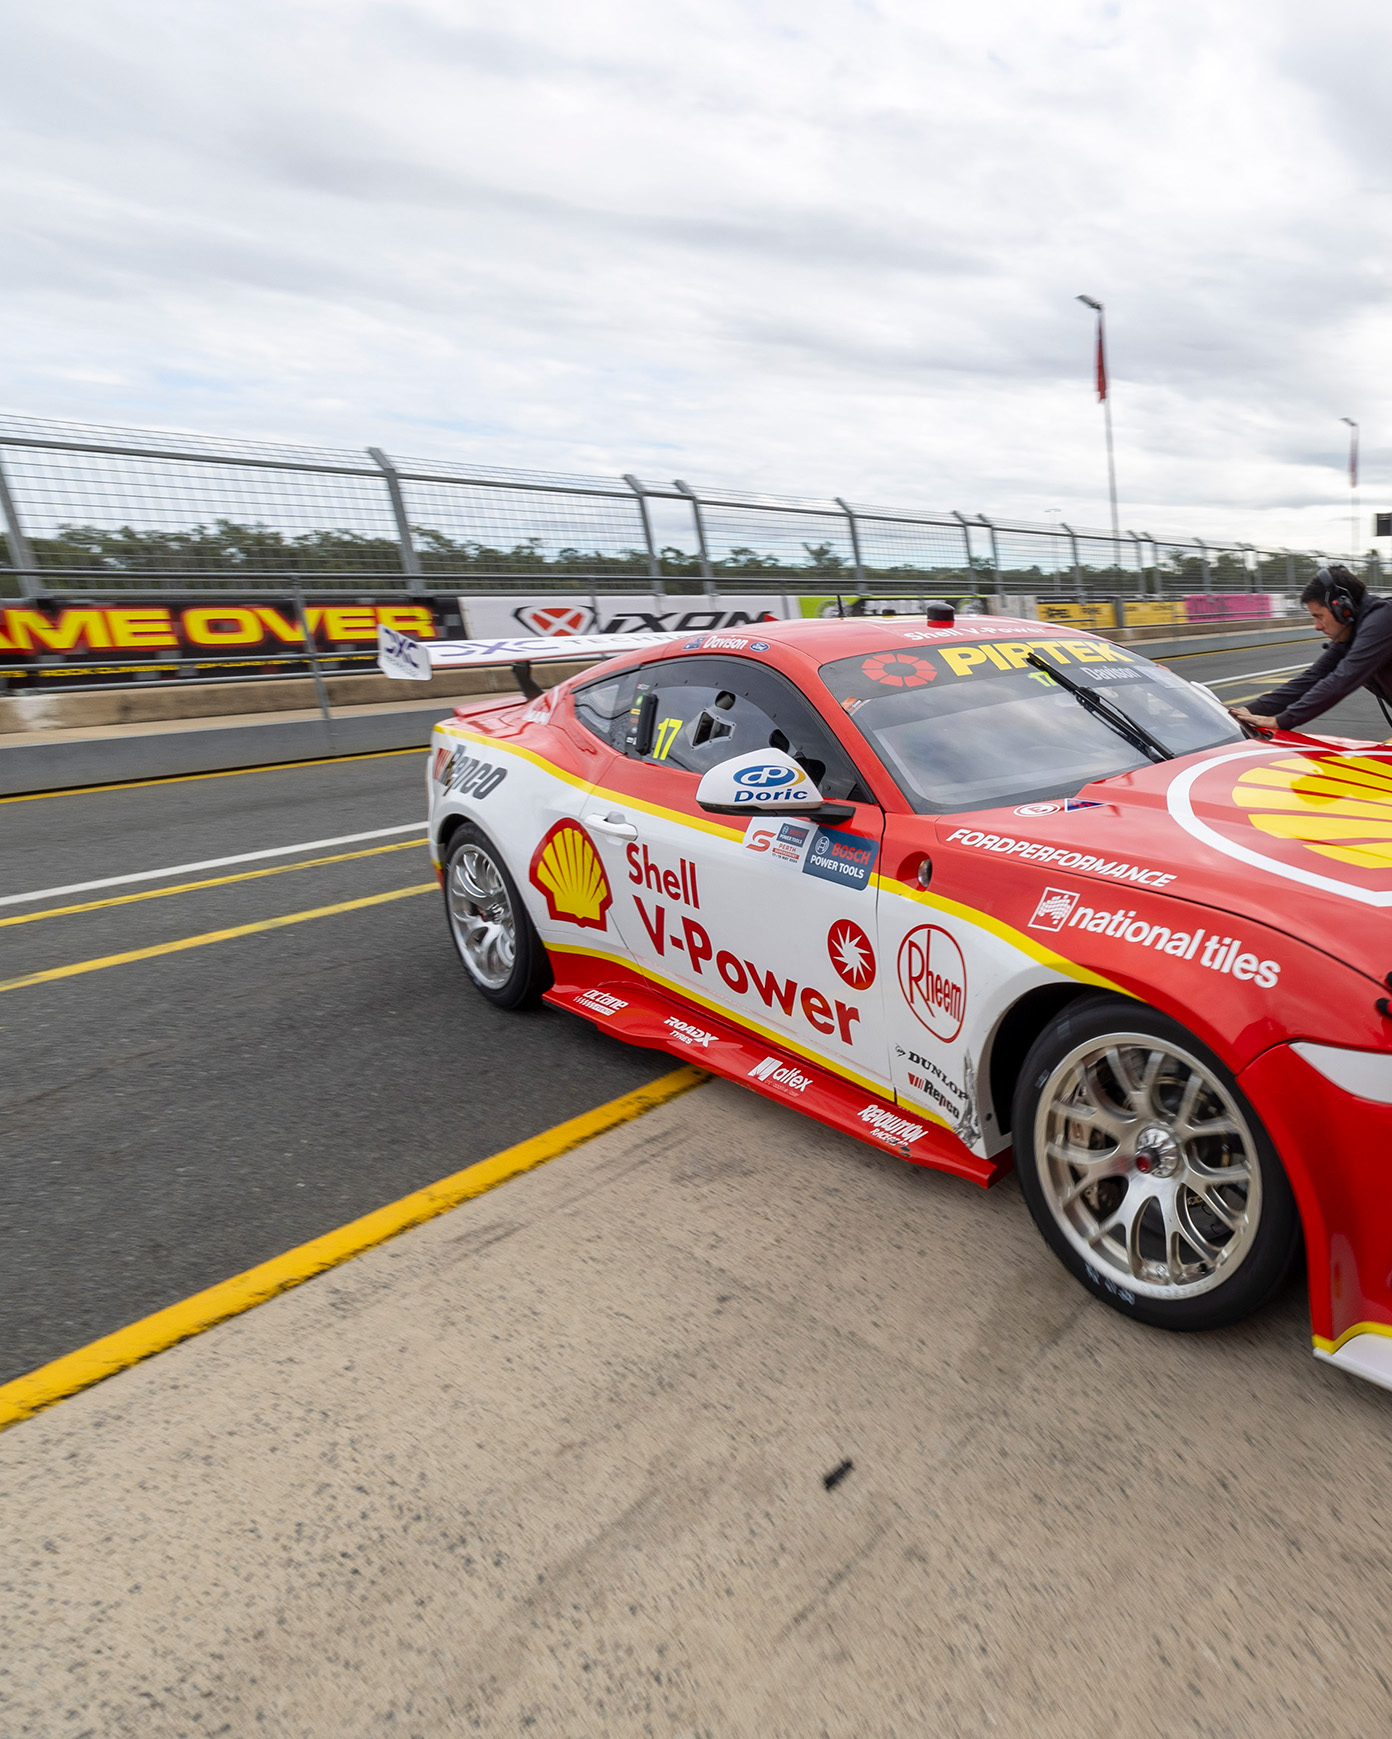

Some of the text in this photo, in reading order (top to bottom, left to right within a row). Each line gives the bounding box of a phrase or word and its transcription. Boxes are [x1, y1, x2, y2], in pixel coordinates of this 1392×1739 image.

[0, 607, 436, 649] ME OVER
[703, 635, 749, 650] Davison
[903, 626, 1046, 641] Shell V-Power
[937, 640, 1135, 677] PIRTEK
[1080, 666, 1142, 681] Davison
[652, 718, 684, 761] 17
[734, 788, 808, 802] Doric
[809, 854, 865, 879] POWER TOOLS
[831, 842, 871, 865] BOSCH
[626, 841, 700, 910] Shell
[1067, 906, 1282, 989] national tiles
[632, 894, 861, 1046] V-Power
[908, 929, 962, 1023] Rheem
[663, 1016, 720, 1048] ROADX
[772, 1067, 814, 1092] alfex
[907, 1050, 969, 1100] DUNLOP
[923, 1078, 960, 1120] Repco
[857, 1104, 929, 1143] REVOLUTION
